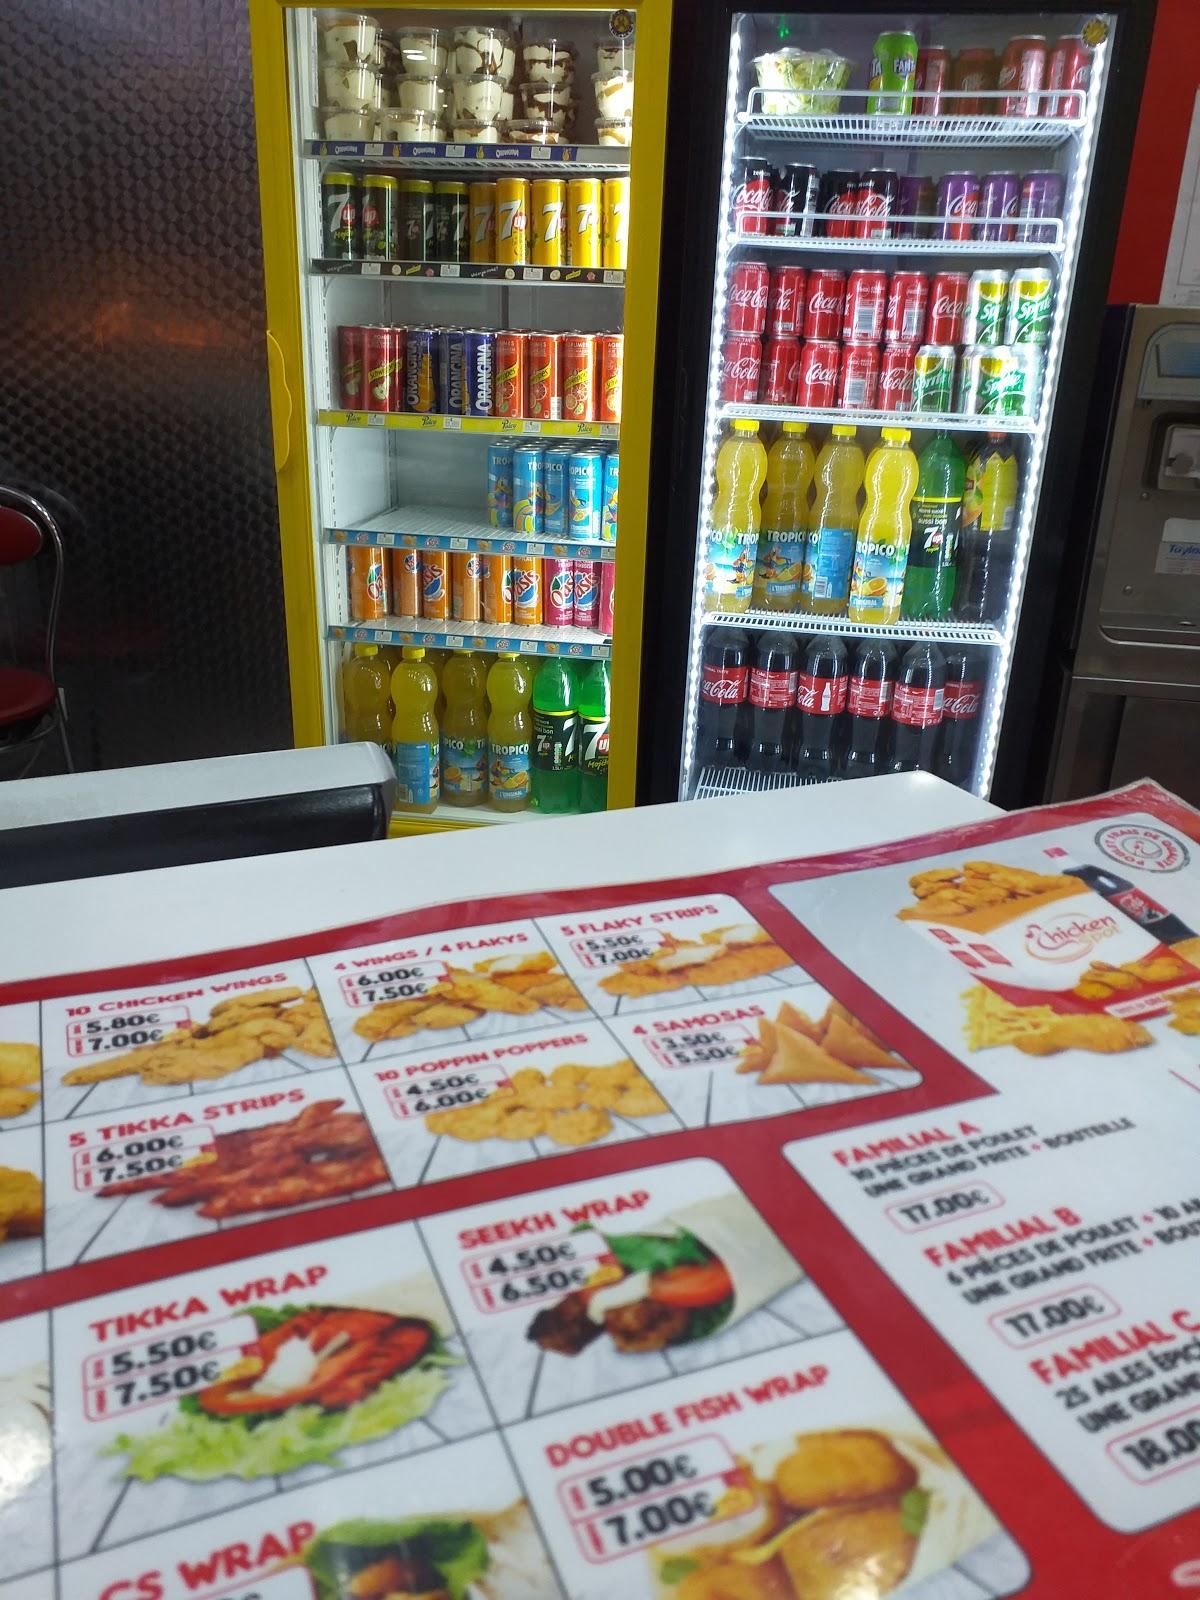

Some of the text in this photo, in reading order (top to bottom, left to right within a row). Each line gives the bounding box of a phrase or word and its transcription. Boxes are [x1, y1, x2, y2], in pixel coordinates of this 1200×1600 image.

[406, 340, 420, 406] ORANGINA
[449, 342, 463, 408] ORANGINA
[475, 343, 493, 411] ORANGINA
[492, 744, 529, 756] TROPICO
[560, 904, 720, 937] 5 FLAKY STRIPS
[351, 949, 420, 971] WINGS
[440, 943, 452, 954] 4
[456, 932, 530, 953] FLAKYS
[583, 934, 644, 952] 5.50€
[594, 946, 656, 966] 7.00€
[65, 973, 288, 1018] 10 CHICKEN WINGS
[358, 967, 425, 987] 6.00€
[362, 982, 430, 1003] 7.50€
[86, 1013, 161, 1034] 5.80€
[632, 1005, 766, 1036] 4 SAMOSAS
[88, 1029, 165, 1052] 7.00€
[375, 1033, 589, 1083] 10 POPPIN POPPERS
[405, 1073, 481, 1096] 4.50€
[413, 1088, 489, 1114] 6.00€
[69, 1088, 305, 1148] 5 TIKKA STRIPS
[967, 1123, 1039, 1152] POULET
[96, 1135, 183, 1164] 6.00€
[832, 1120, 983, 1168] FAMILIAL A
[99, 1154, 184, 1183] 7.50€
[458, 1189, 652, 1251] SEEKH WRAP
[898, 1187, 991, 1225] 17.00€
[922, 1206, 1083, 1268] FAMILIAL B
[1063, 1216, 1142, 1251] POULET
[487, 1244, 577, 1275] 4.50€
[89, 1264, 330, 1344] TIKKA WRAP
[500, 1268, 588, 1304] 6.50€
[1003, 1295, 1107, 1340] 17.00€
[111, 1330, 219, 1377] 5.50€
[1028, 1320, 1177, 1385] FAMILIAL
[114, 1360, 222, 1408] 7.50€
[543, 1364, 831, 1469] DOUBLE FISH WRAP
[587, 1454, 698, 1509] 5.00€
[604, 1490, 720, 1547] 7.00€
[176, 1519, 316, 1591] WRAP
